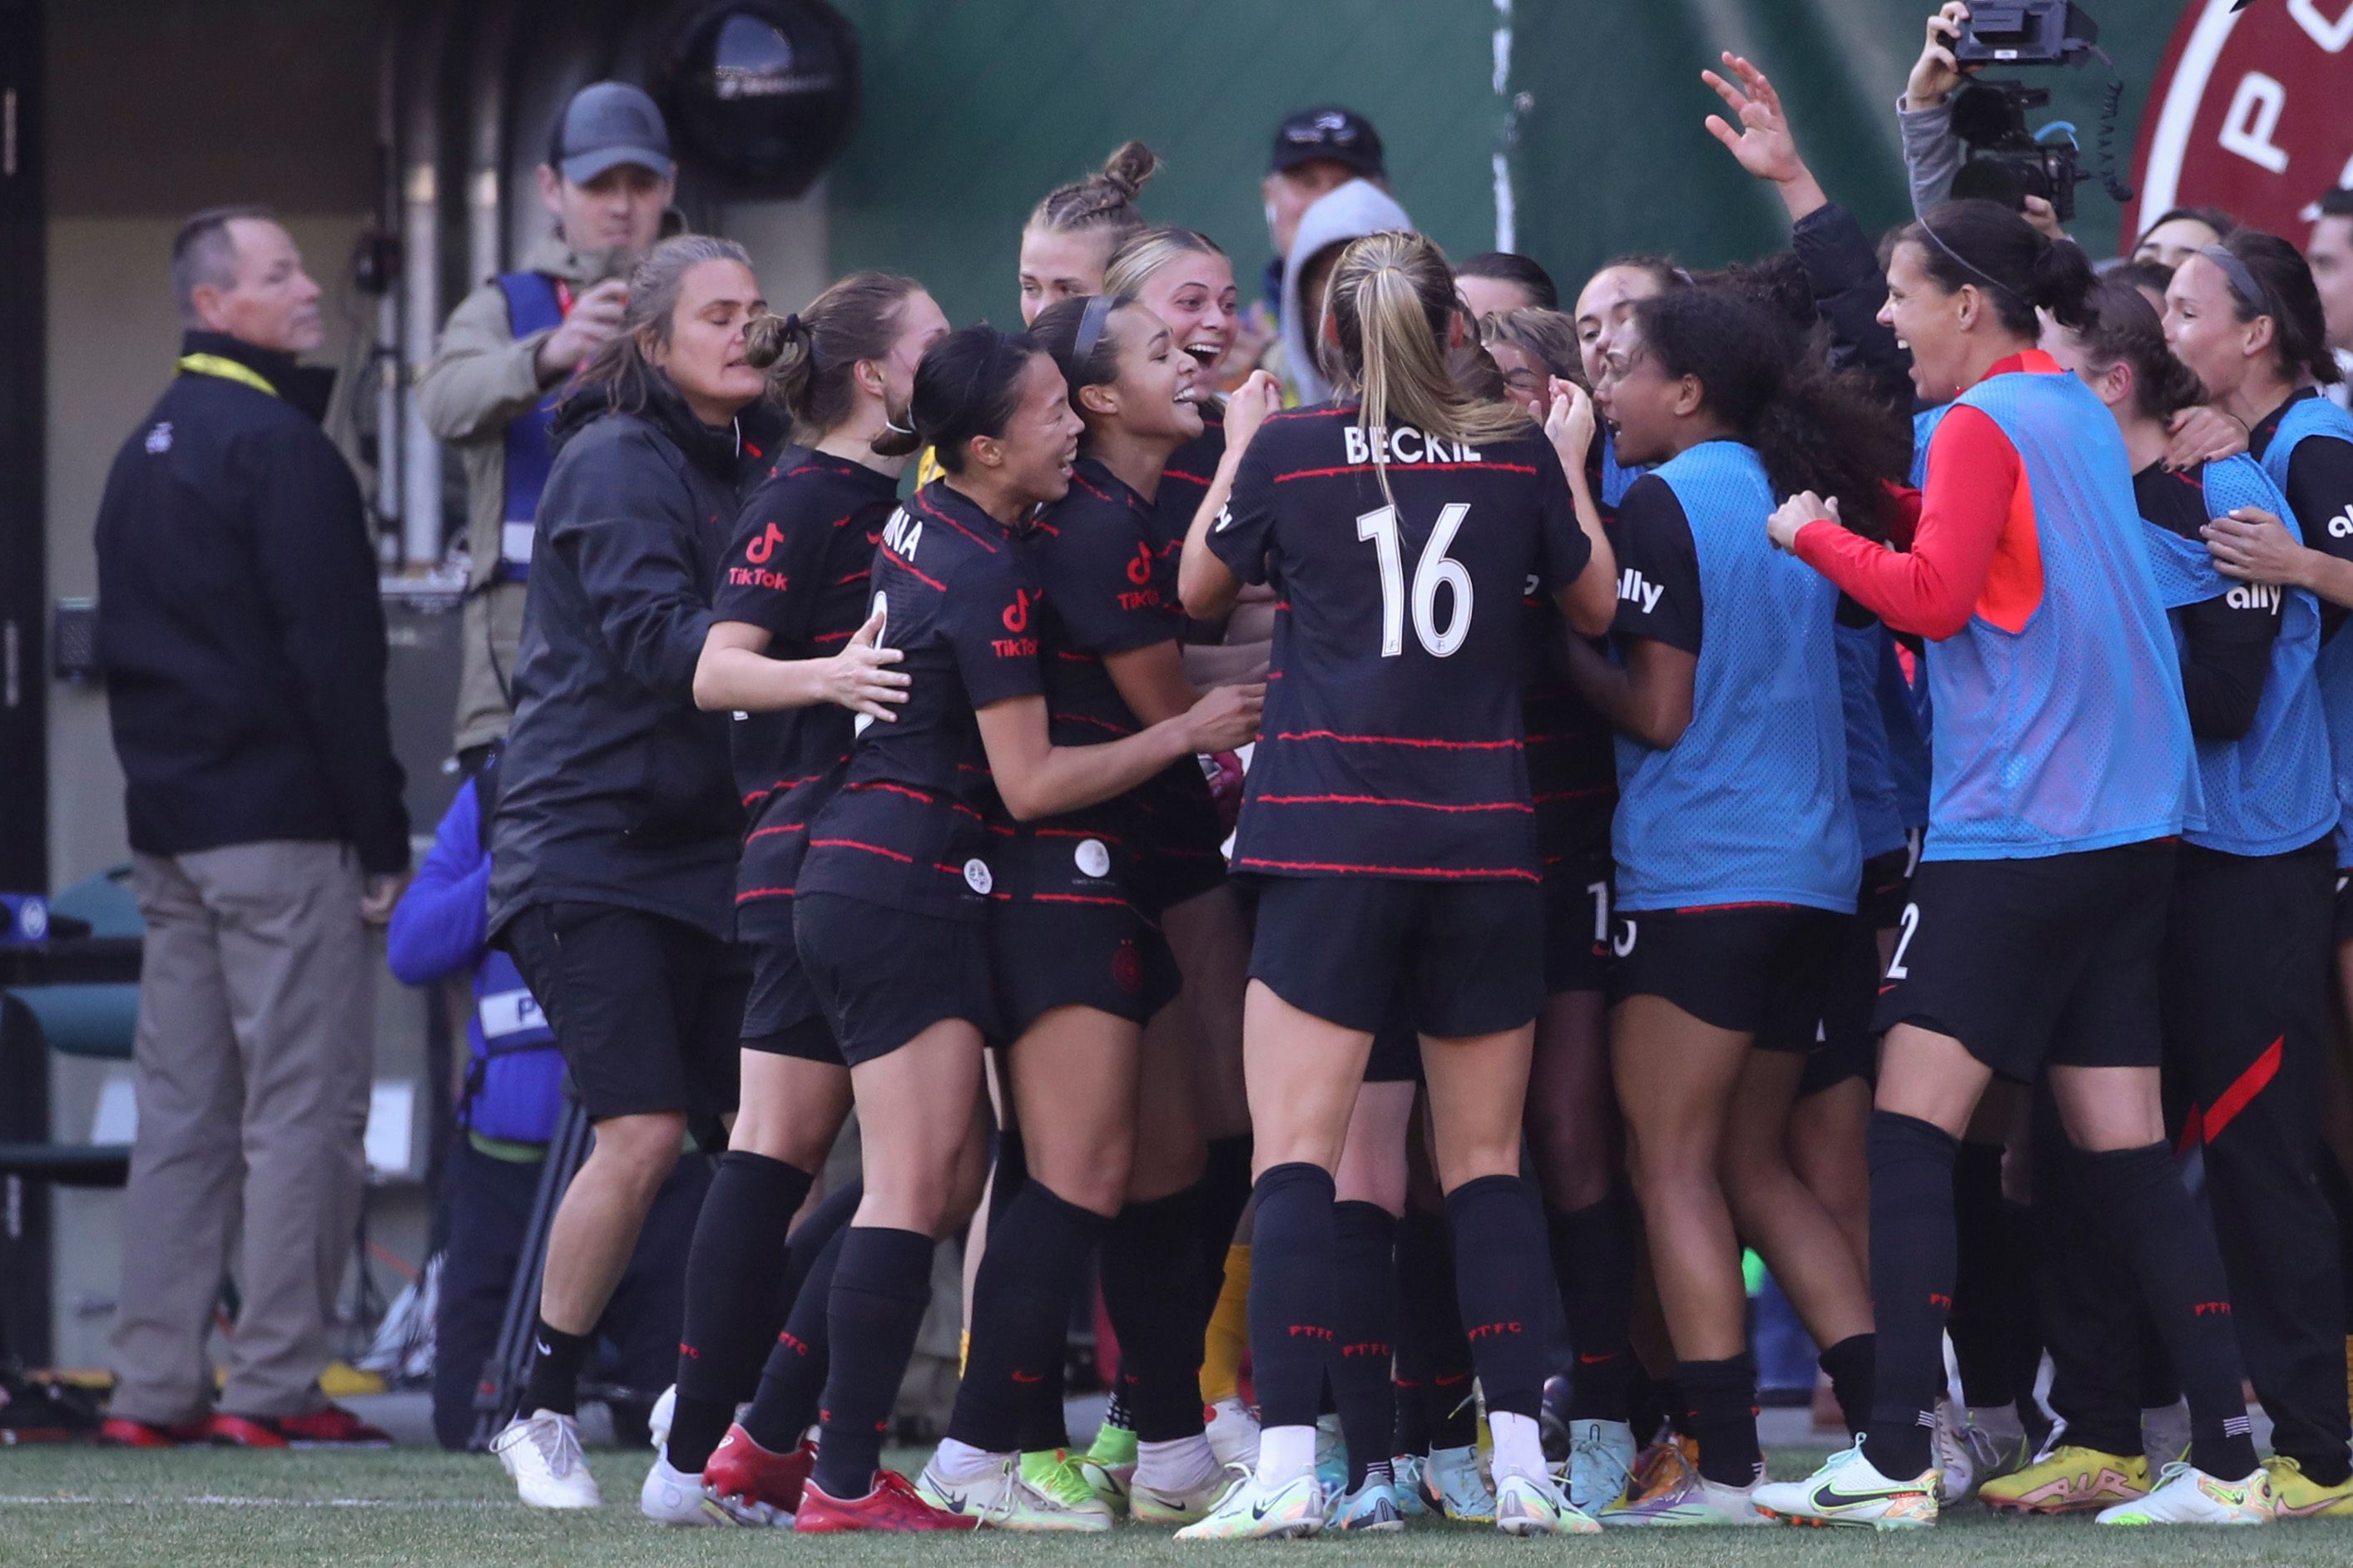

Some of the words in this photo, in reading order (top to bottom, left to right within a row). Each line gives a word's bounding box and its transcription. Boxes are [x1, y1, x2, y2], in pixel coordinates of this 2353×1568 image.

[729, 567, 789, 591] TikTok
[1356, 503, 1474, 657] 16
[1617, 567, 1665, 614] lly
[2226, 583, 2281, 616] ally
